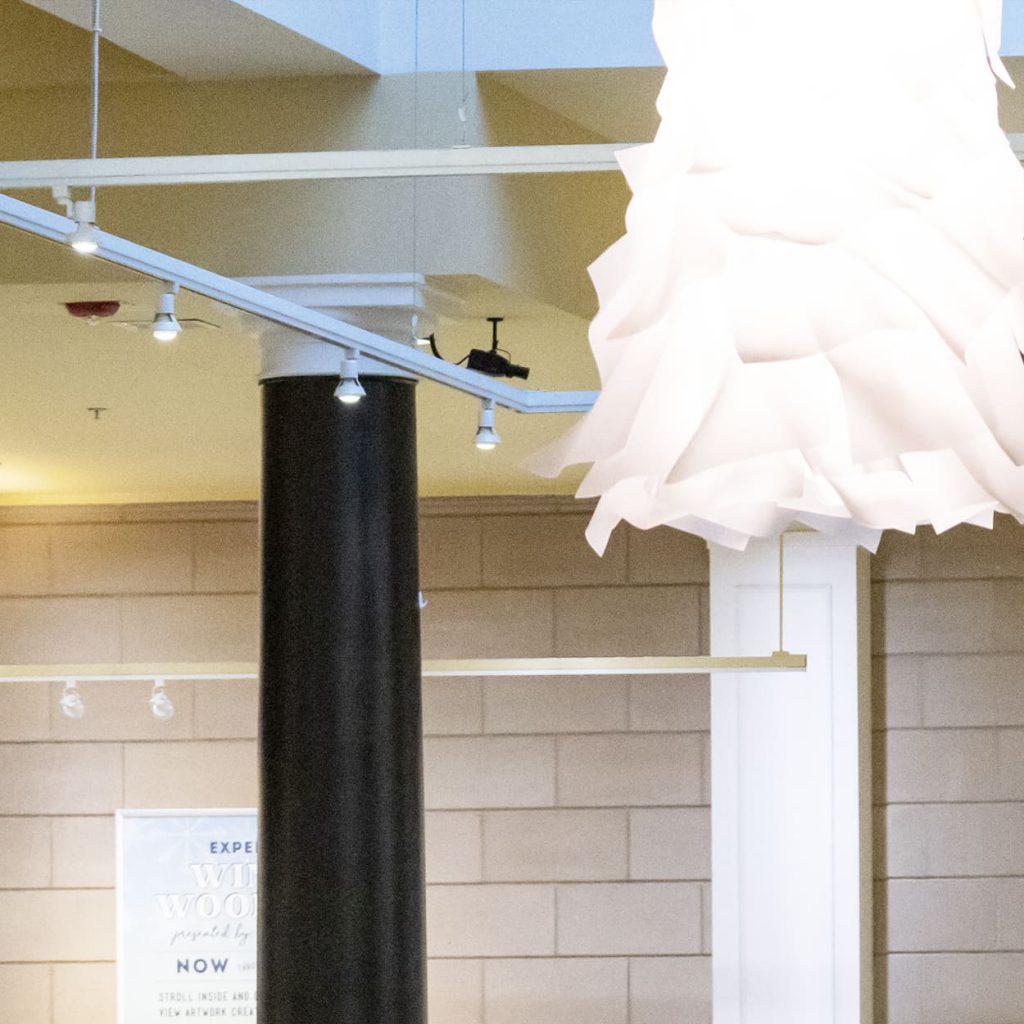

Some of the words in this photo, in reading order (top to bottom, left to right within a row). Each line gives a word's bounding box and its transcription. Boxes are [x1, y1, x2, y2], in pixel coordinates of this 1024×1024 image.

[210, 841, 257, 853] EXPE
[154, 893, 257, 918] WOO
[177, 958, 228, 973] NOW
[159, 992, 192, 1002] STROLL
[198, 991, 227, 1002] INSIDE
[232, 991, 250, 1002] AND
[160, 1007, 180, 1017] VIEW
[185, 1007, 227, 1017] ARTWORK
[231, 1007, 257, 1017] CREA
